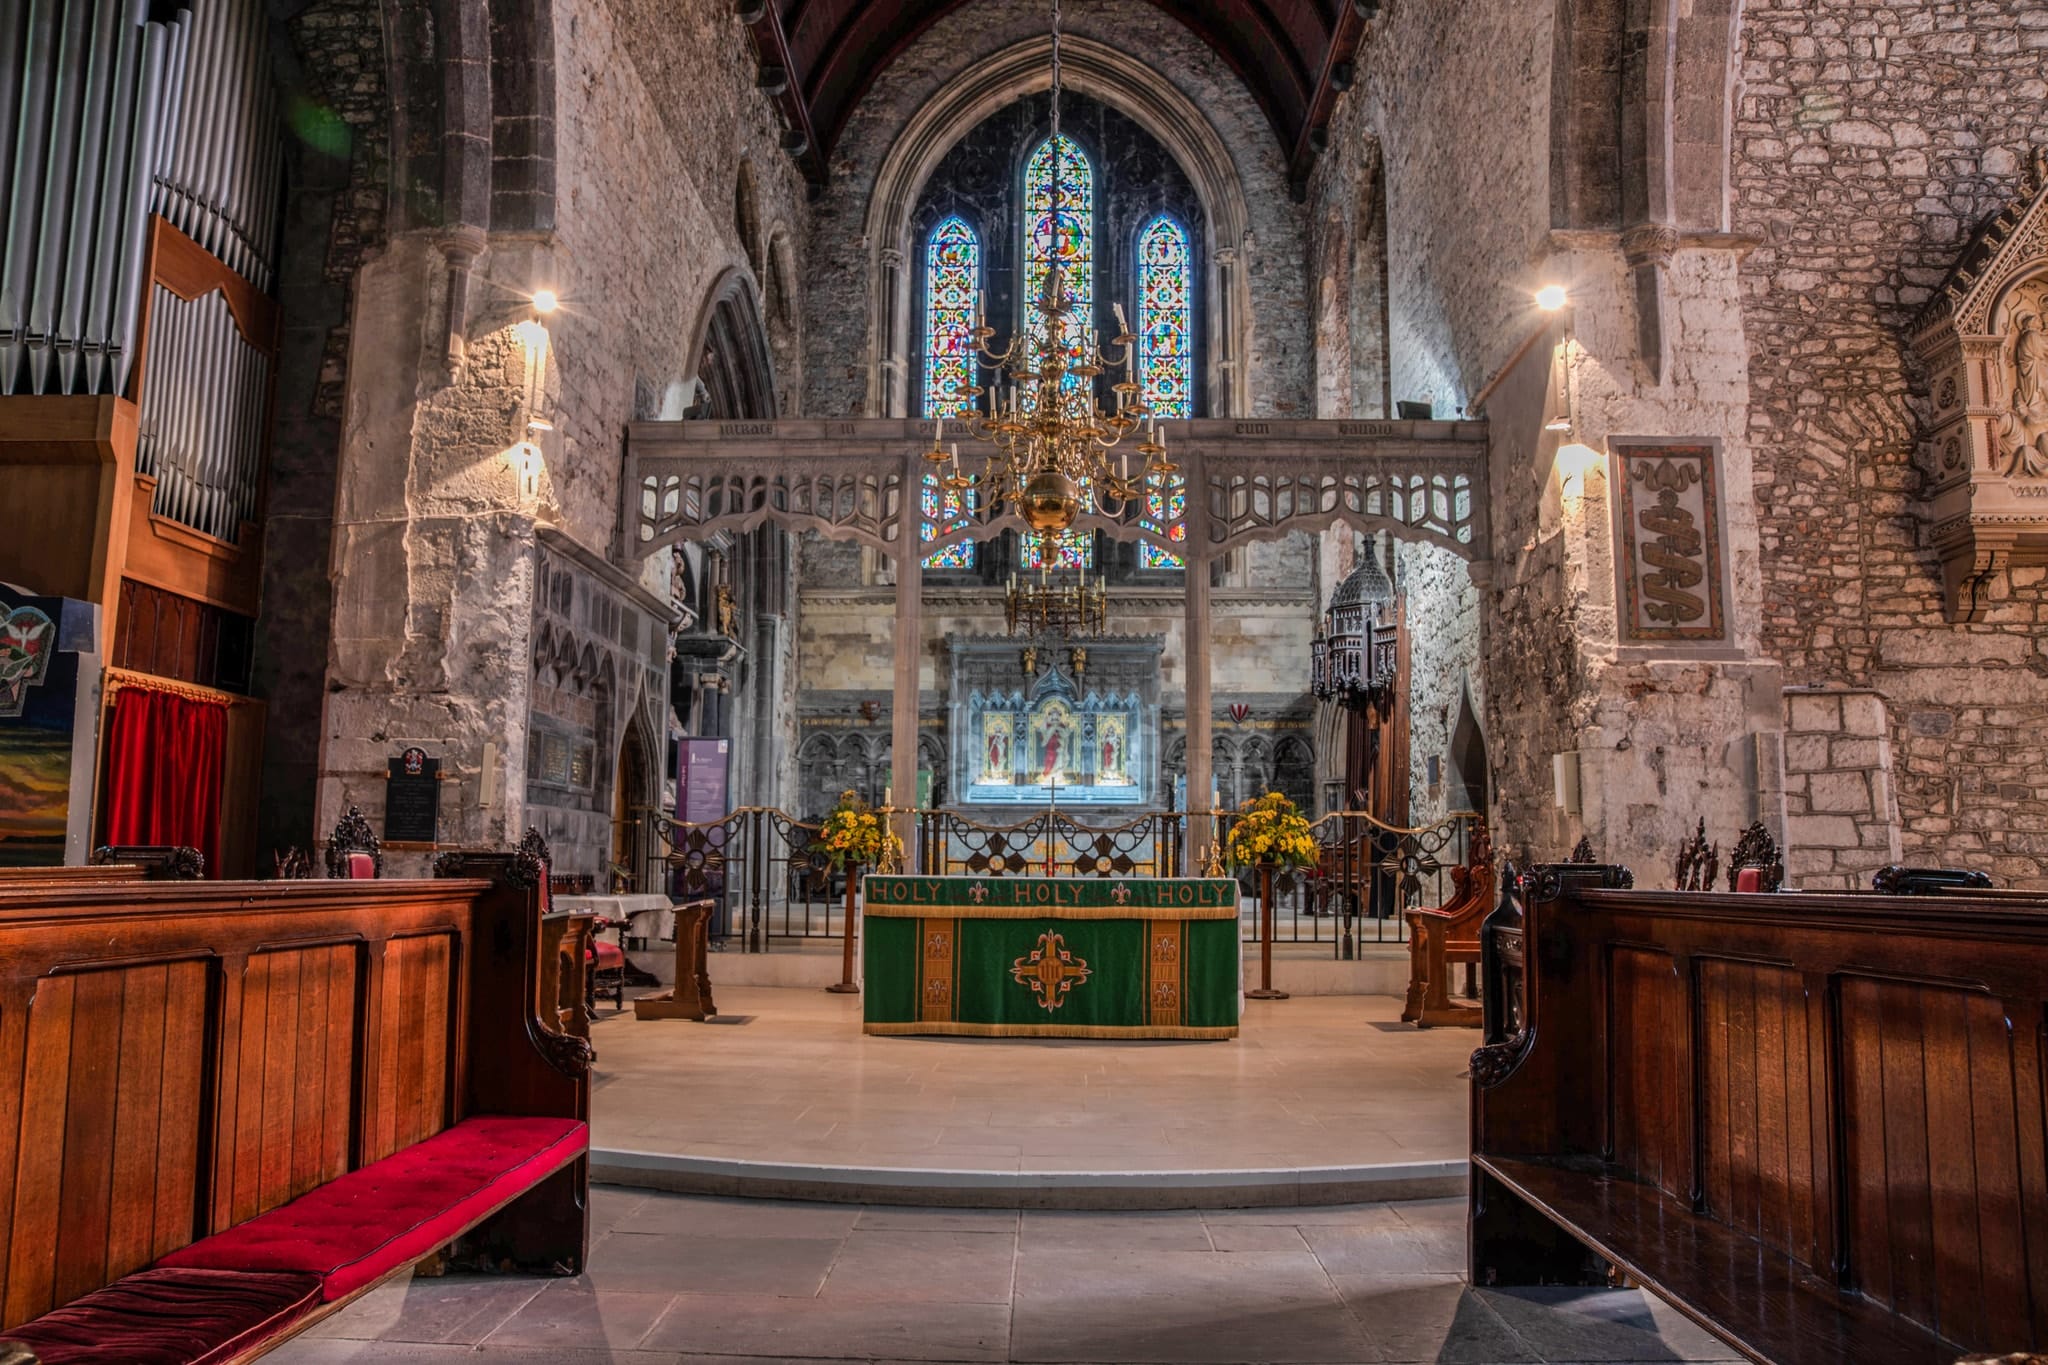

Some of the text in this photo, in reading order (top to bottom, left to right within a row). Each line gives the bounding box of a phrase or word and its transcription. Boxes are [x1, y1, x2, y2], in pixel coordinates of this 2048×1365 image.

[1235, 422, 1270, 435] cum
[872, 881, 1228, 904] HOLY HOLY HOLY
